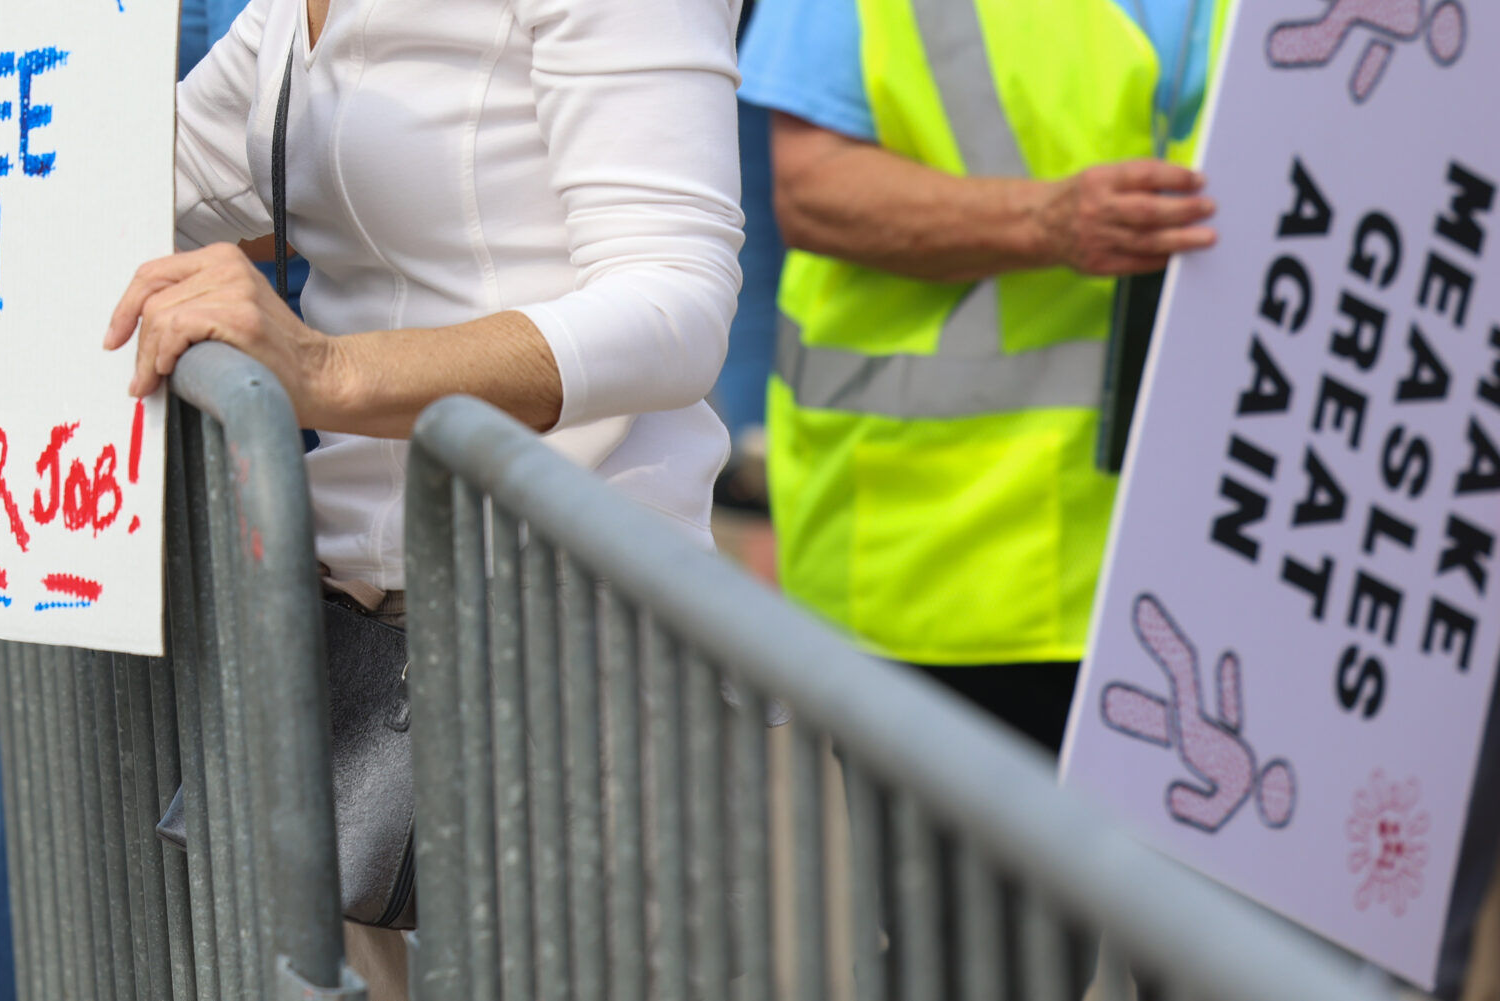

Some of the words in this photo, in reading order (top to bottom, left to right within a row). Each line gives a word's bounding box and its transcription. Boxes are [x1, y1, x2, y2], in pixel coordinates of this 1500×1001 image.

[29, 396, 147, 540] JOB!
[1209, 157, 1334, 563] AGAIN
[1280, 210, 1403, 621] GREAT
[1334, 159, 1498, 719] MEASLES
